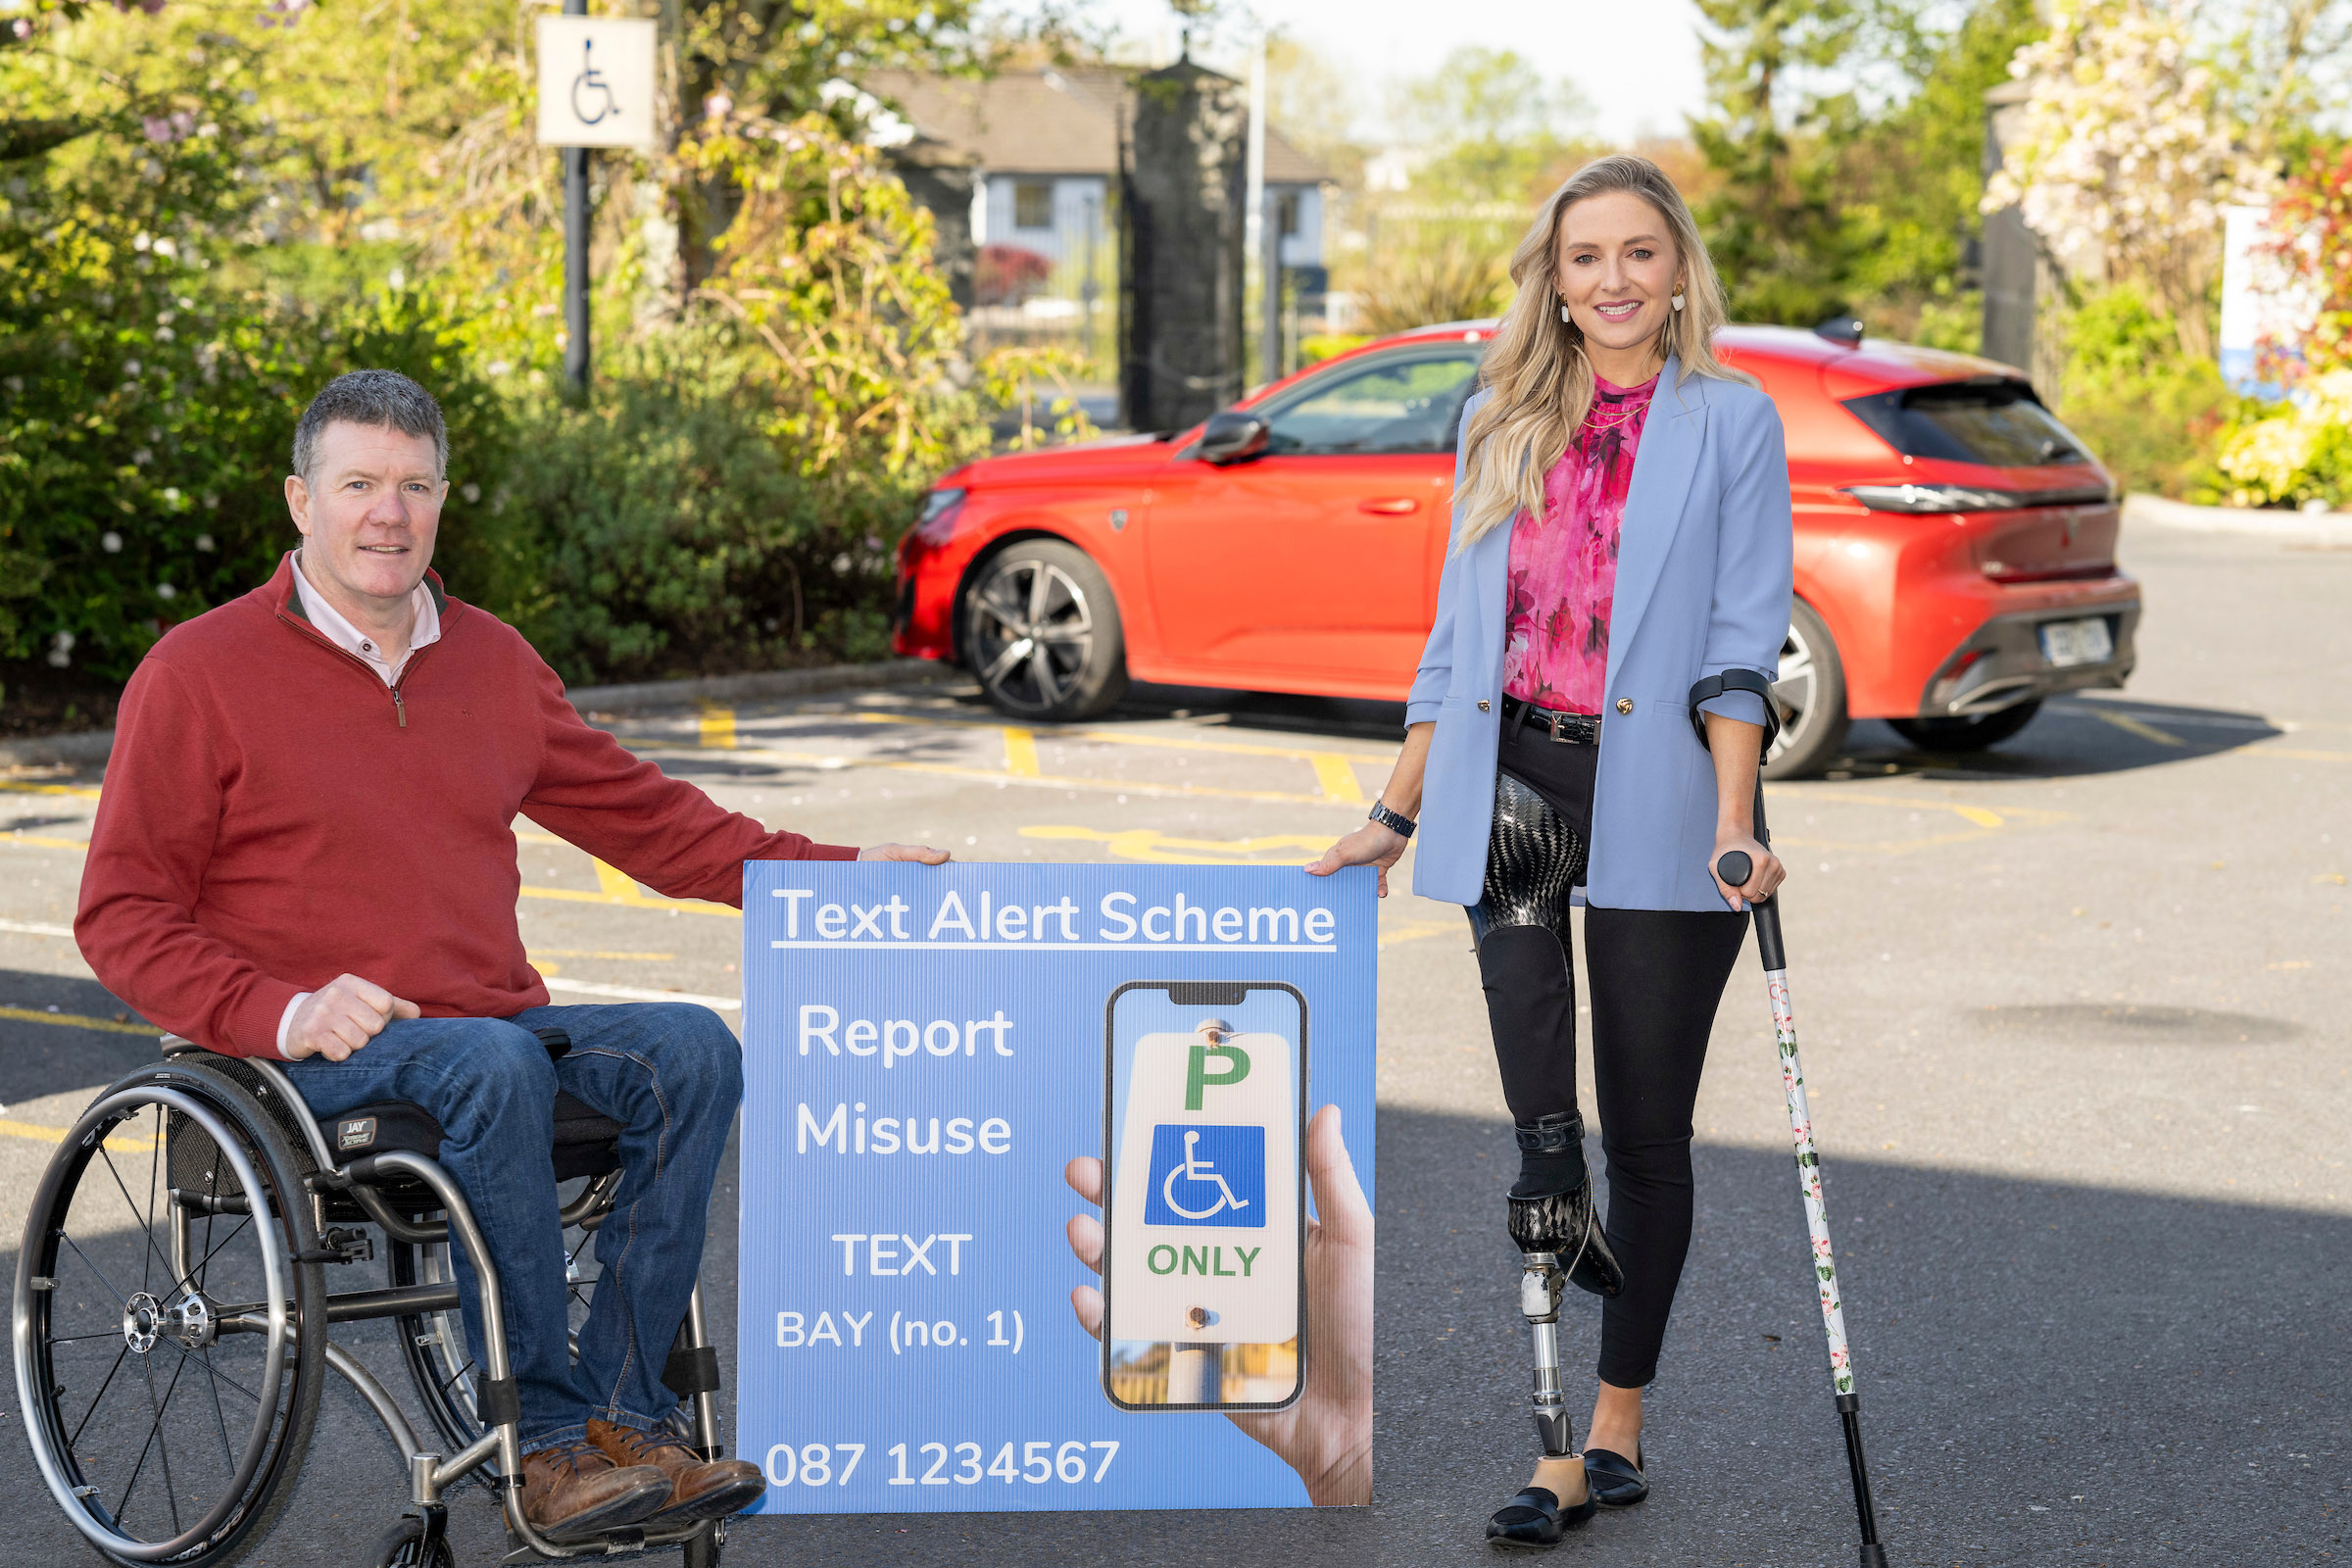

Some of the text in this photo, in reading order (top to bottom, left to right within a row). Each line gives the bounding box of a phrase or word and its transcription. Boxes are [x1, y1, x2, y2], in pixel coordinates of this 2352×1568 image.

[771, 888, 1336, 944] Text Alert Scheme
[798, 1004, 1014, 1069] Report
[1184, 1045, 1251, 1111] P
[346, 1121, 366, 1134] JAY
[796, 1102, 1011, 1155] Misuse
[831, 1233, 973, 1277] TEXT
[1147, 1244, 1262, 1277] ONLY
[775, 1309, 1024, 1355] BAY (no. 1)
[765, 1441, 1120, 1488] 087 1234567
